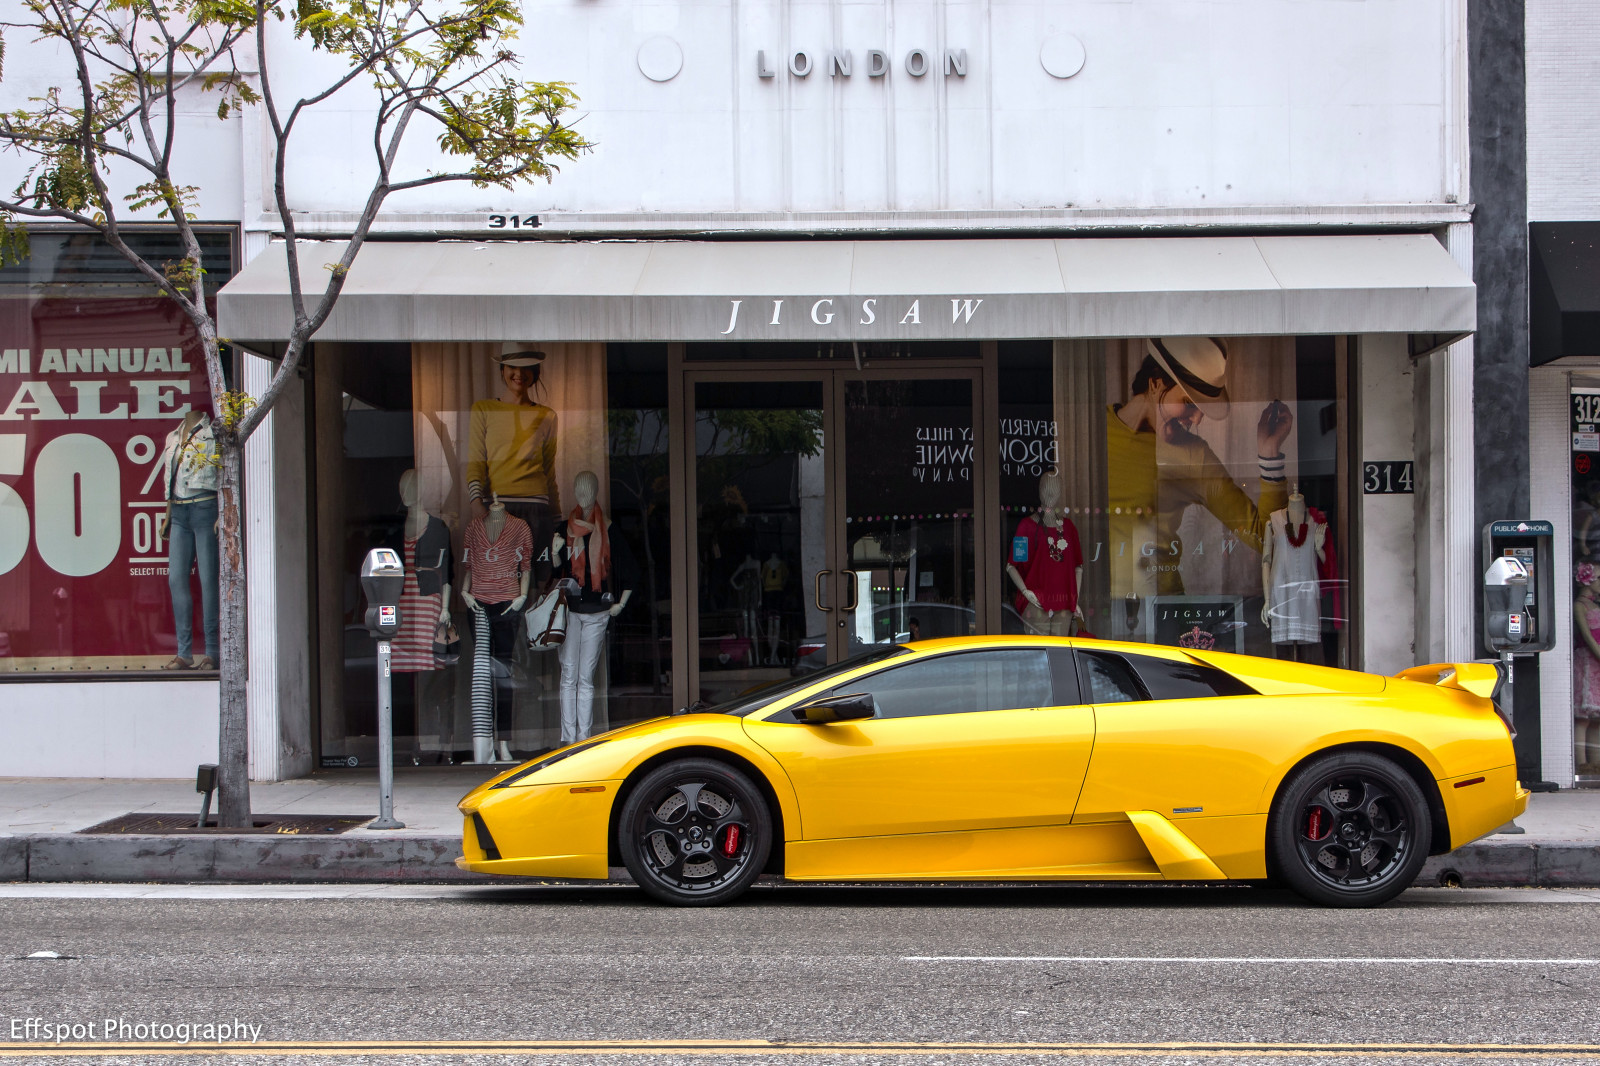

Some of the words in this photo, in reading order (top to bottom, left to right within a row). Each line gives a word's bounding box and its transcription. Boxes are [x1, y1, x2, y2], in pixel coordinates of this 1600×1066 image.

[757, 49, 967, 78] LONDON
[488, 214, 543, 228] 314
[721, 298, 984, 334] JIGSAW
[39, 347, 191, 373] ANNUAL
[1574, 395, 1600, 423] 312
[1364, 463, 1413, 492] 314
[133, 512, 167, 553] OF
[433, 545, 586, 569] JIGSAW
[1090, 540, 1239, 562] JIGSAW
[130, 567, 155, 576] SELECT
[1162, 610, 1227, 620] JIGSAW
